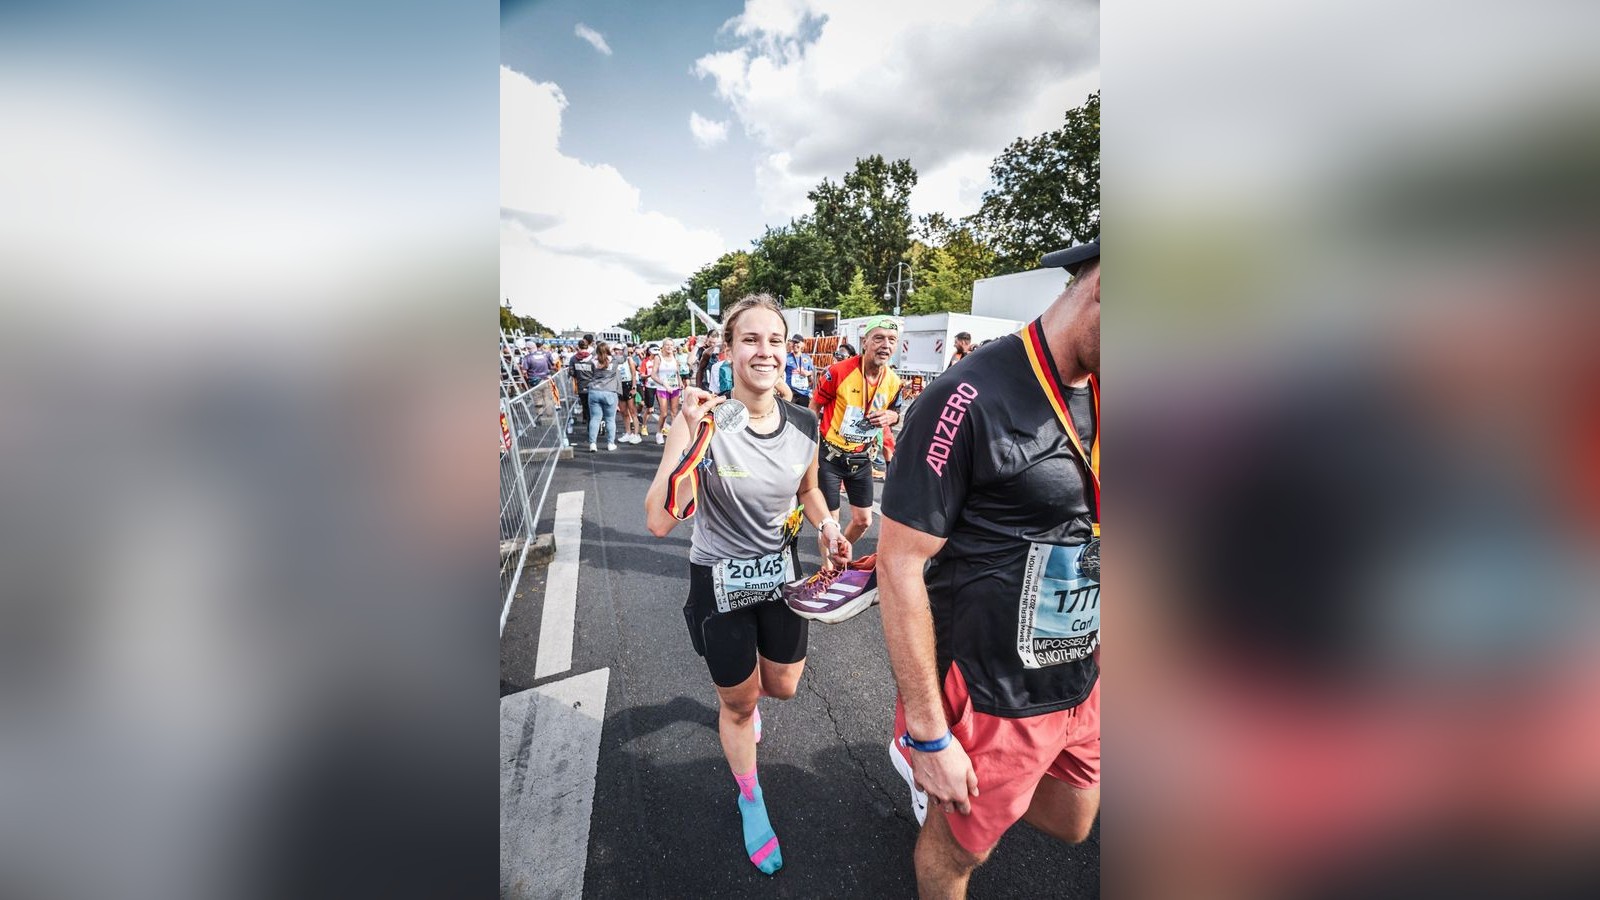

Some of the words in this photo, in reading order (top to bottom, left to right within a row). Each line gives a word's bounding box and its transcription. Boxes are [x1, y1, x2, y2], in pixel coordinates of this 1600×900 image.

[926, 382, 978, 477] ADIZERO
[730, 559, 783, 579] 20145
[744, 581, 774, 589] Emma
[1020, 555, 1036, 624] BERLIN-MARATHON
[1029, 594, 1037, 611] 2023
[1071, 615, 1094, 632] Carl
[1035, 653, 1046, 665] IS
[1045, 647, 1087, 663] NOTHING
